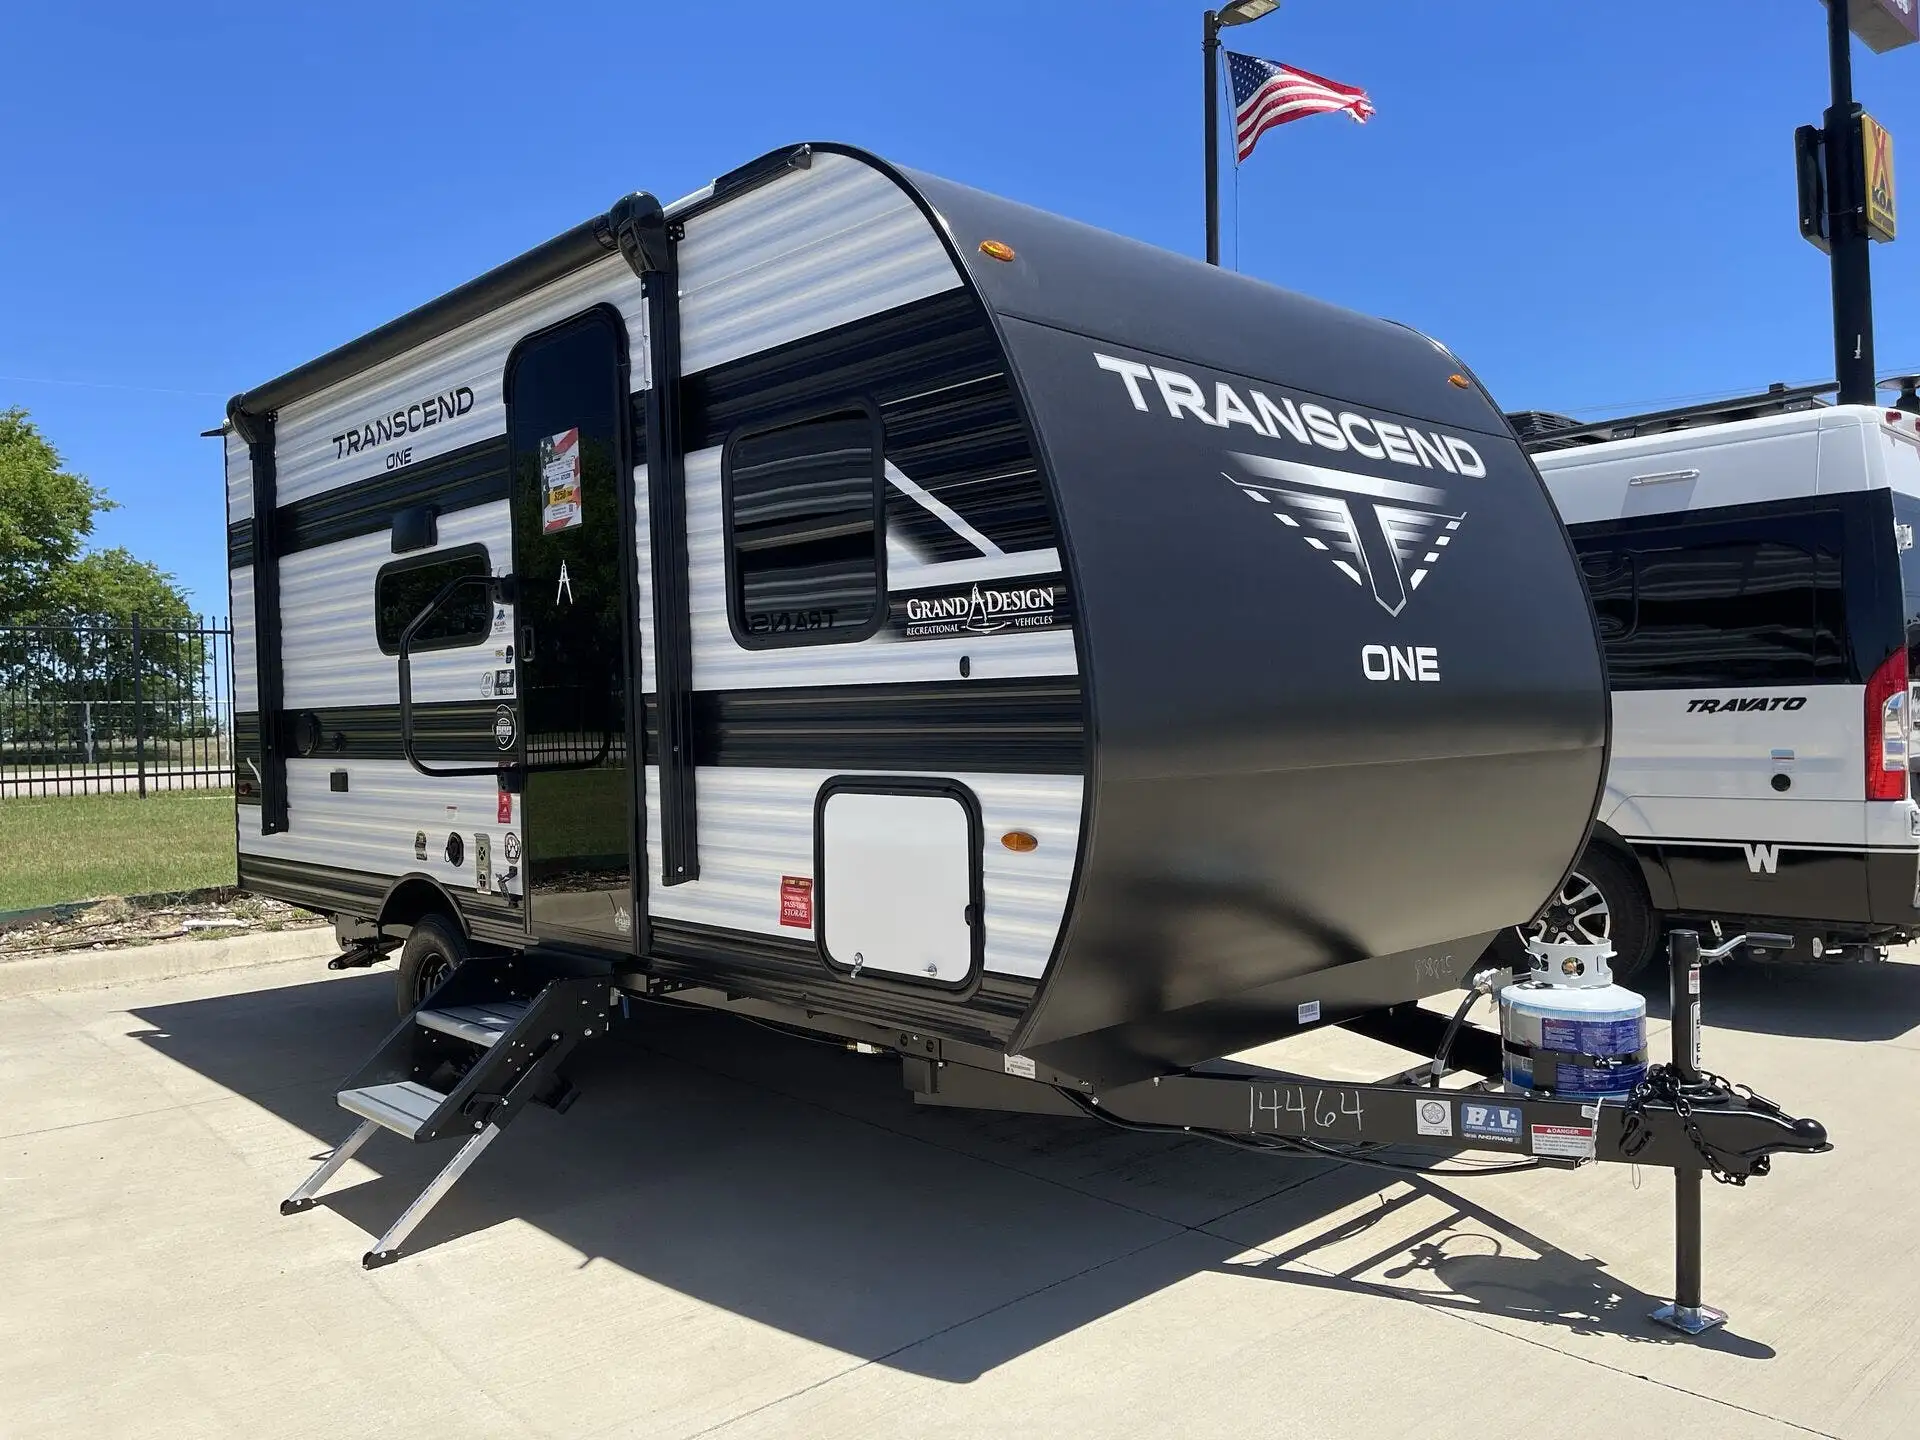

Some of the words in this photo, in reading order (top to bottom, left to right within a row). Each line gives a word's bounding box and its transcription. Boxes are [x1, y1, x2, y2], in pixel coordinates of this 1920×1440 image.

[332, 386, 474, 460] TRANSCEND
[1092, 352, 1487, 479] TRANSCEND
[386, 446, 413, 470] ONE
[906, 596, 969, 620] GRAND
[983, 587, 1054, 613] DESIGN
[906, 623, 959, 636] RECREATIONAL
[1014, 615, 1053, 627] VEHICLES
[1361, 644, 1441, 682] ONE
[1685, 697, 1808, 714] TRAVATO
[1744, 844, 1779, 874] W
[1249, 1086, 1364, 1132] 14464
[1466, 1106, 1518, 1129] BAL
